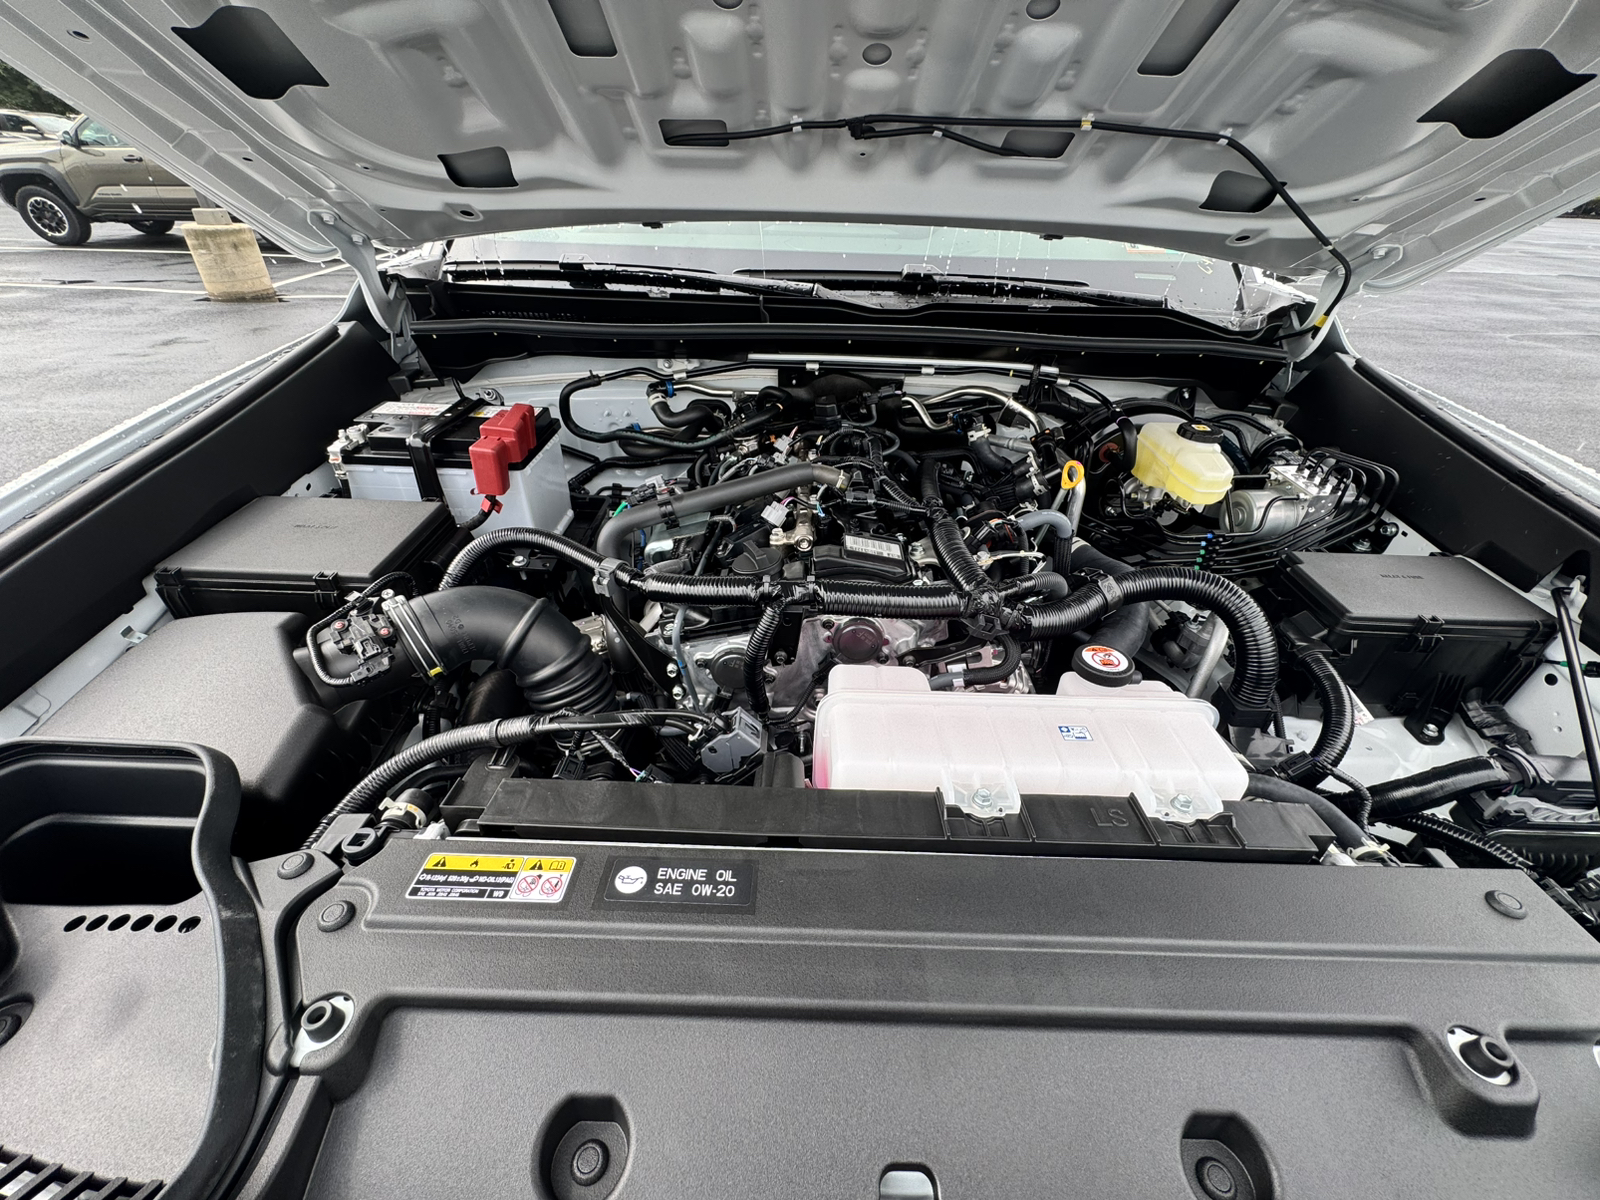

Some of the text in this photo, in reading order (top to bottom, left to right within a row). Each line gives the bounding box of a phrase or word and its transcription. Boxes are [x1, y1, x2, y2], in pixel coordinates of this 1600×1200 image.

[1090, 807, 1130, 827] LS
[657, 867, 738, 882] ENGINE OIL
[654, 882, 736, 897] SAE 0W-20
